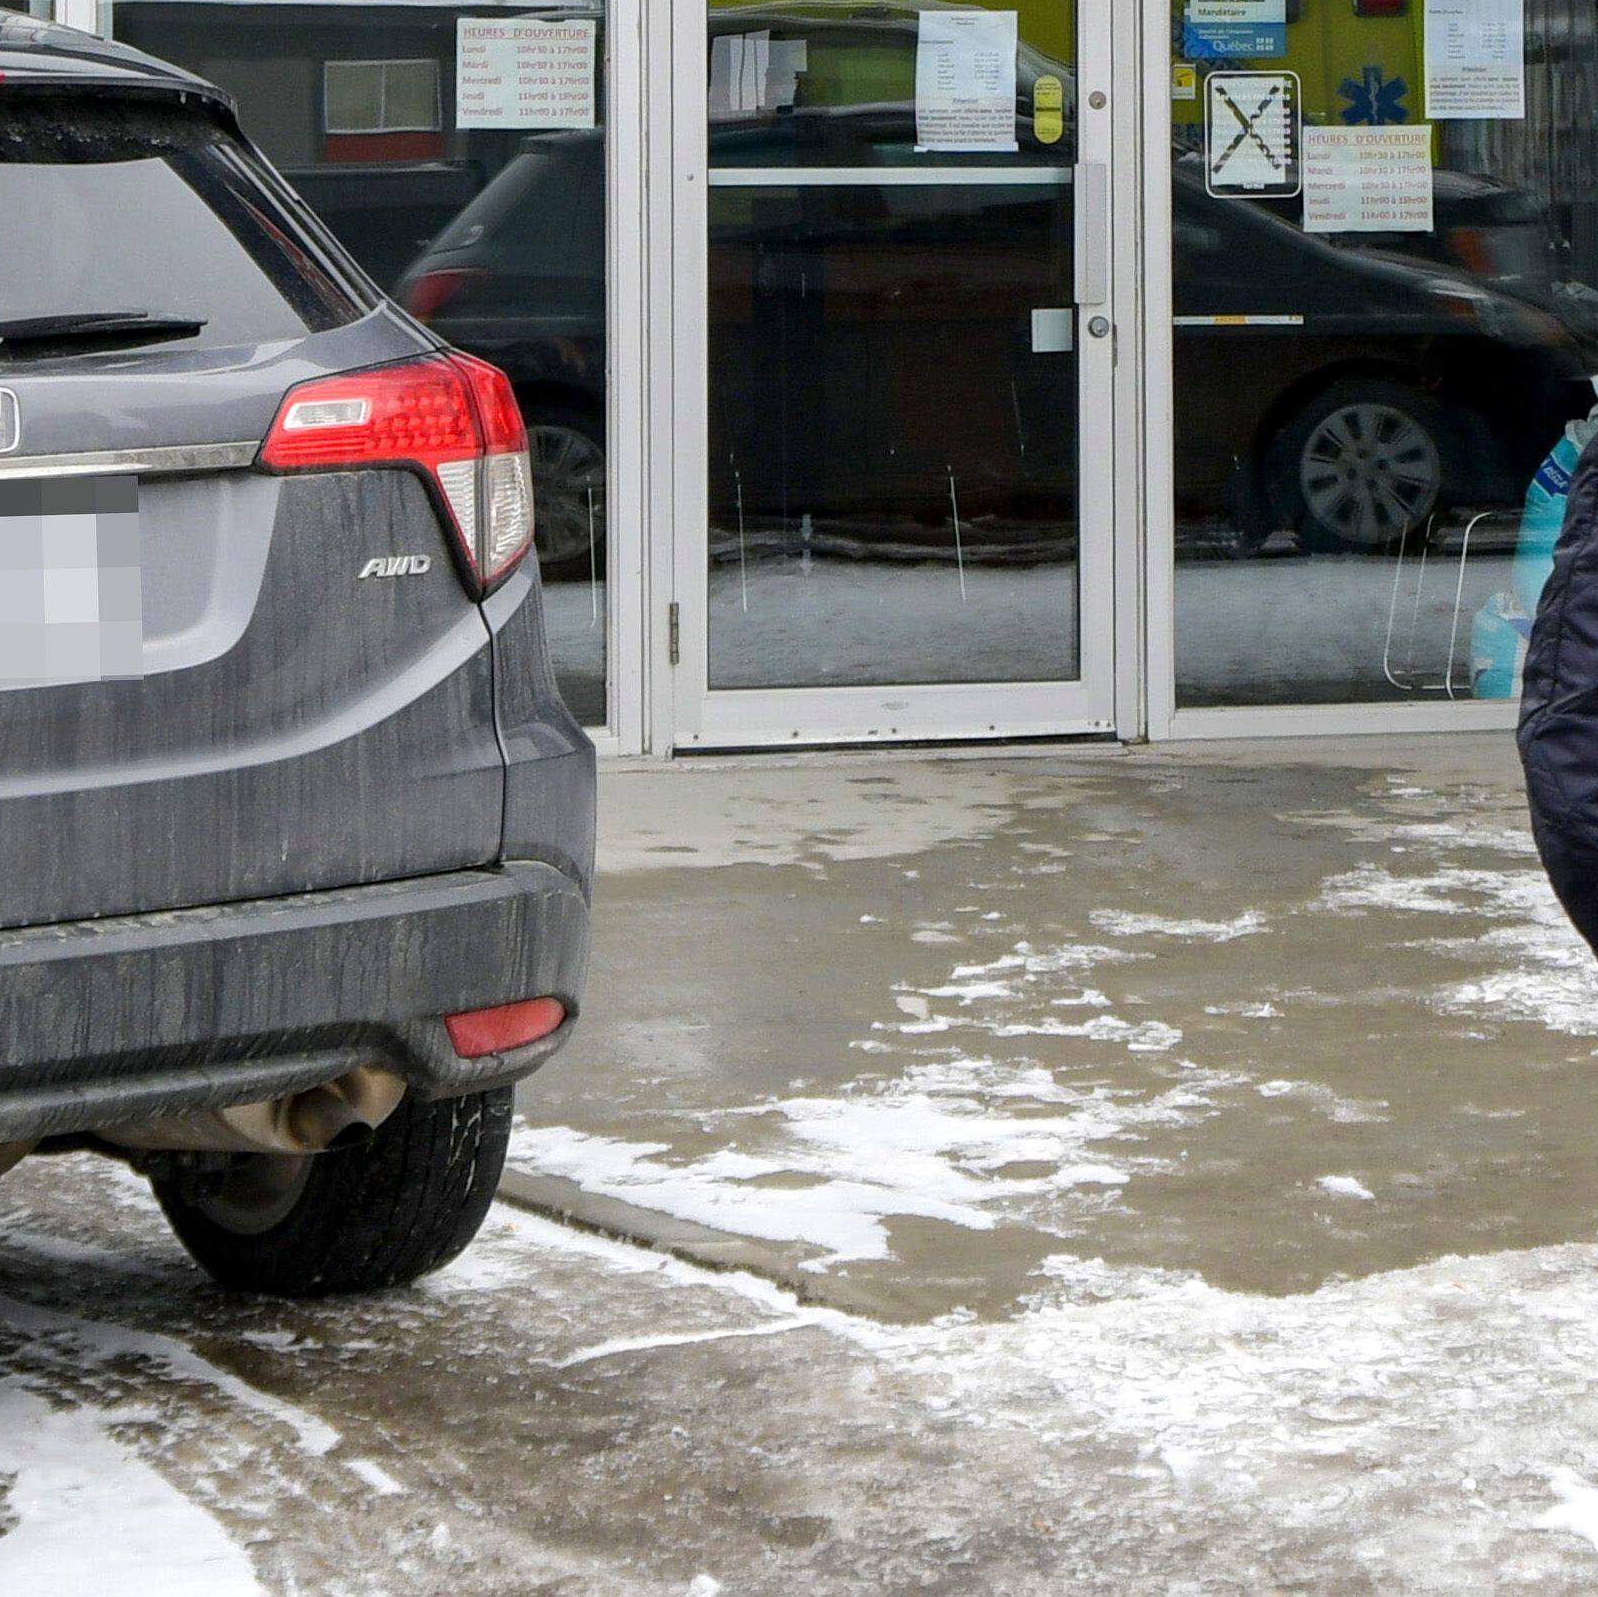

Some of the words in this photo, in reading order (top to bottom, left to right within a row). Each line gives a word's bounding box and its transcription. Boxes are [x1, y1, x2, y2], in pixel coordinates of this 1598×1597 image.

[463, 27, 506, 37] HEURES
[513, 27, 589, 39] D'OUVERTURE
[1212, 40, 1254, 53] Québec
[1307, 134, 1348, 144] HEURES
[1355, 133, 1427, 144] D'OUVERTURE
[357, 554, 432, 579] AWD
